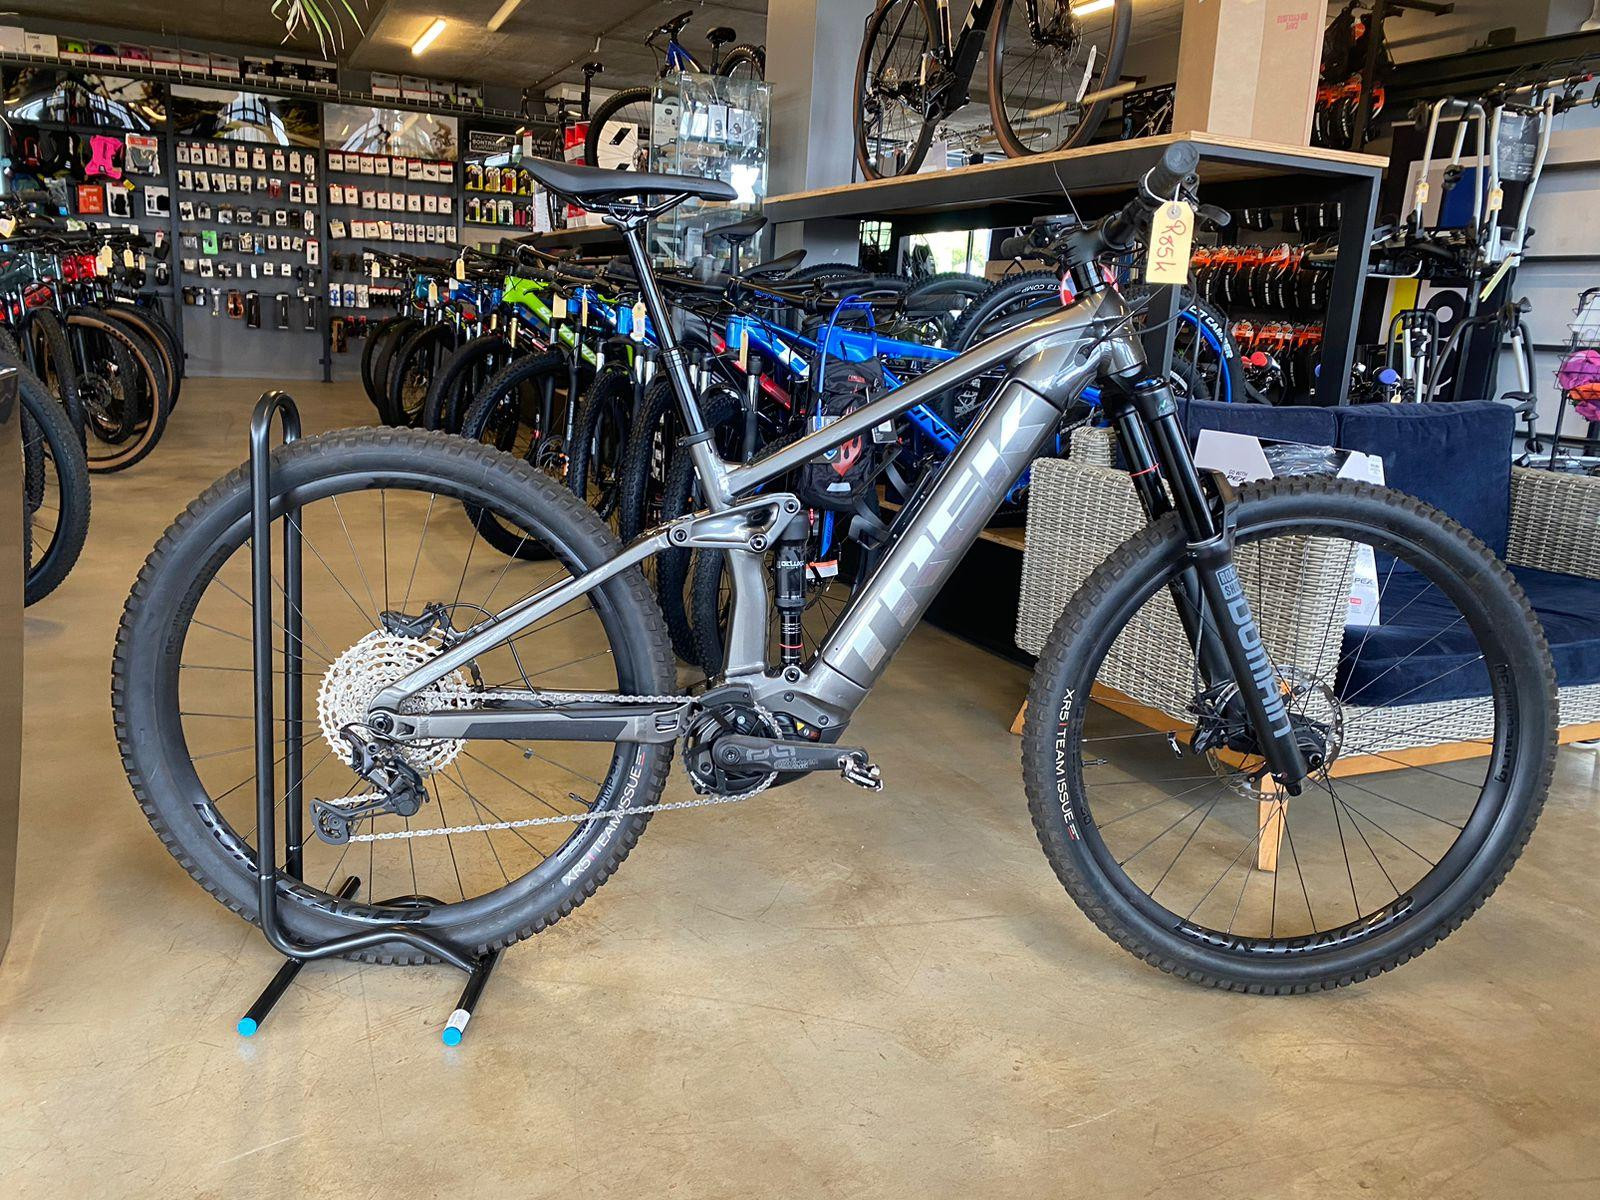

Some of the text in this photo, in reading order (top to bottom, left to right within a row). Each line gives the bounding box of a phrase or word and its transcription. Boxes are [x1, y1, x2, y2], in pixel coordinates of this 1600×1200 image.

[832, 388, 1048, 673] TREK
[1227, 598, 1292, 738] DOMAIN
[1055, 687, 1076, 824] XR5 TEAM ISSUE
